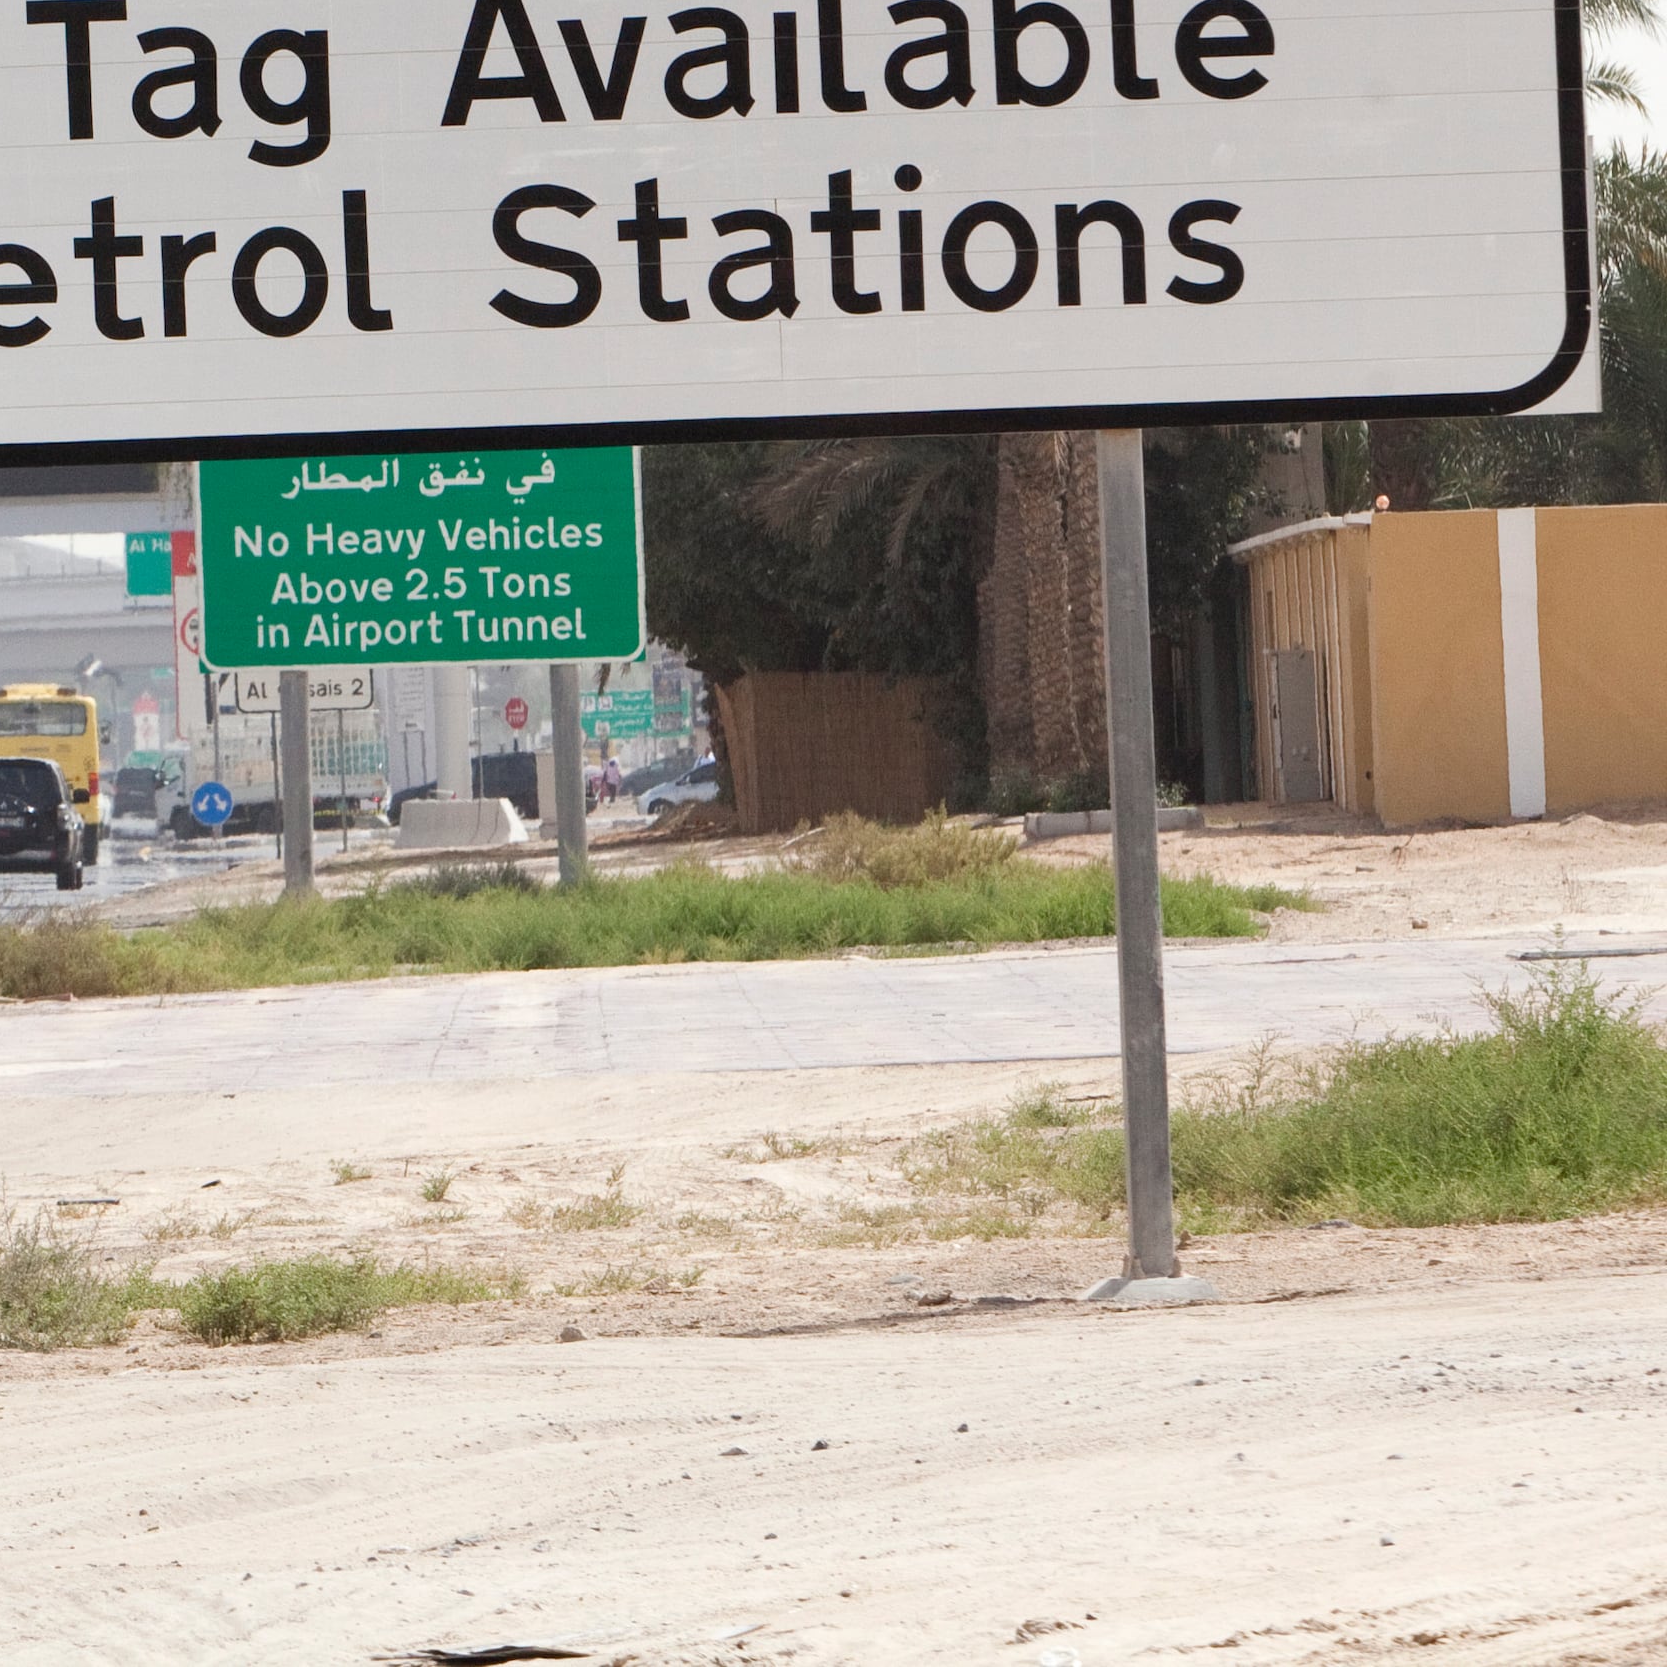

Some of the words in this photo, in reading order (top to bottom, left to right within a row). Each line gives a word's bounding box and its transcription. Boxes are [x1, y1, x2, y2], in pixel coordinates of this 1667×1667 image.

[488, 163, 1245, 329] Stations
[281, 457, 400, 500] المطار
[234, 524, 290, 558] No
[306, 522, 426, 561] Heavy
[437, 516, 603, 552] Vehicles
[271, 572, 394, 605] Above
[404, 566, 467, 601] 2.5
[478, 566, 572, 599] Tons
[256, 614, 290, 648] in
[303, 610, 443, 652] Airport
[454, 607, 587, 643] Tunnel
[349, 676, 365, 697] 2
